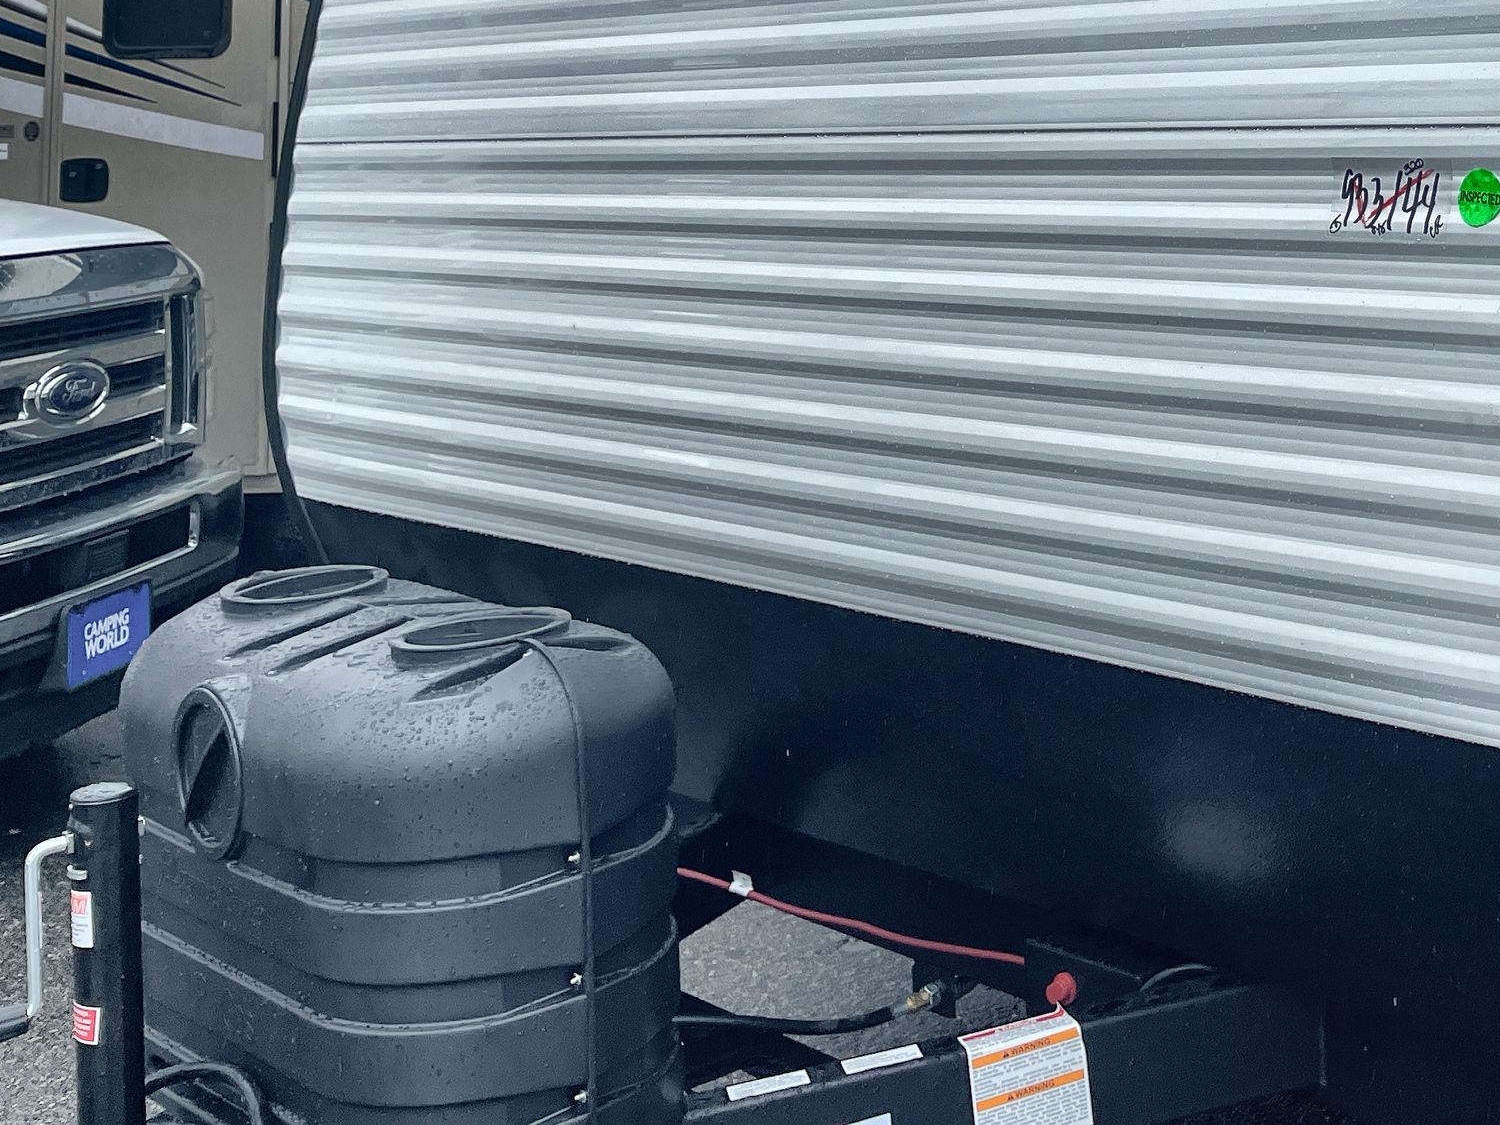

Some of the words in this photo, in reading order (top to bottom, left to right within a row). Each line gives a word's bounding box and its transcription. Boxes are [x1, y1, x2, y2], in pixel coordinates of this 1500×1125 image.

[84, 607, 130, 640] CAMPING
[84, 625, 130, 660] WORLD
[1011, 1037, 1051, 1056] WARNING
[1016, 1079, 1056, 1098] WARNING
